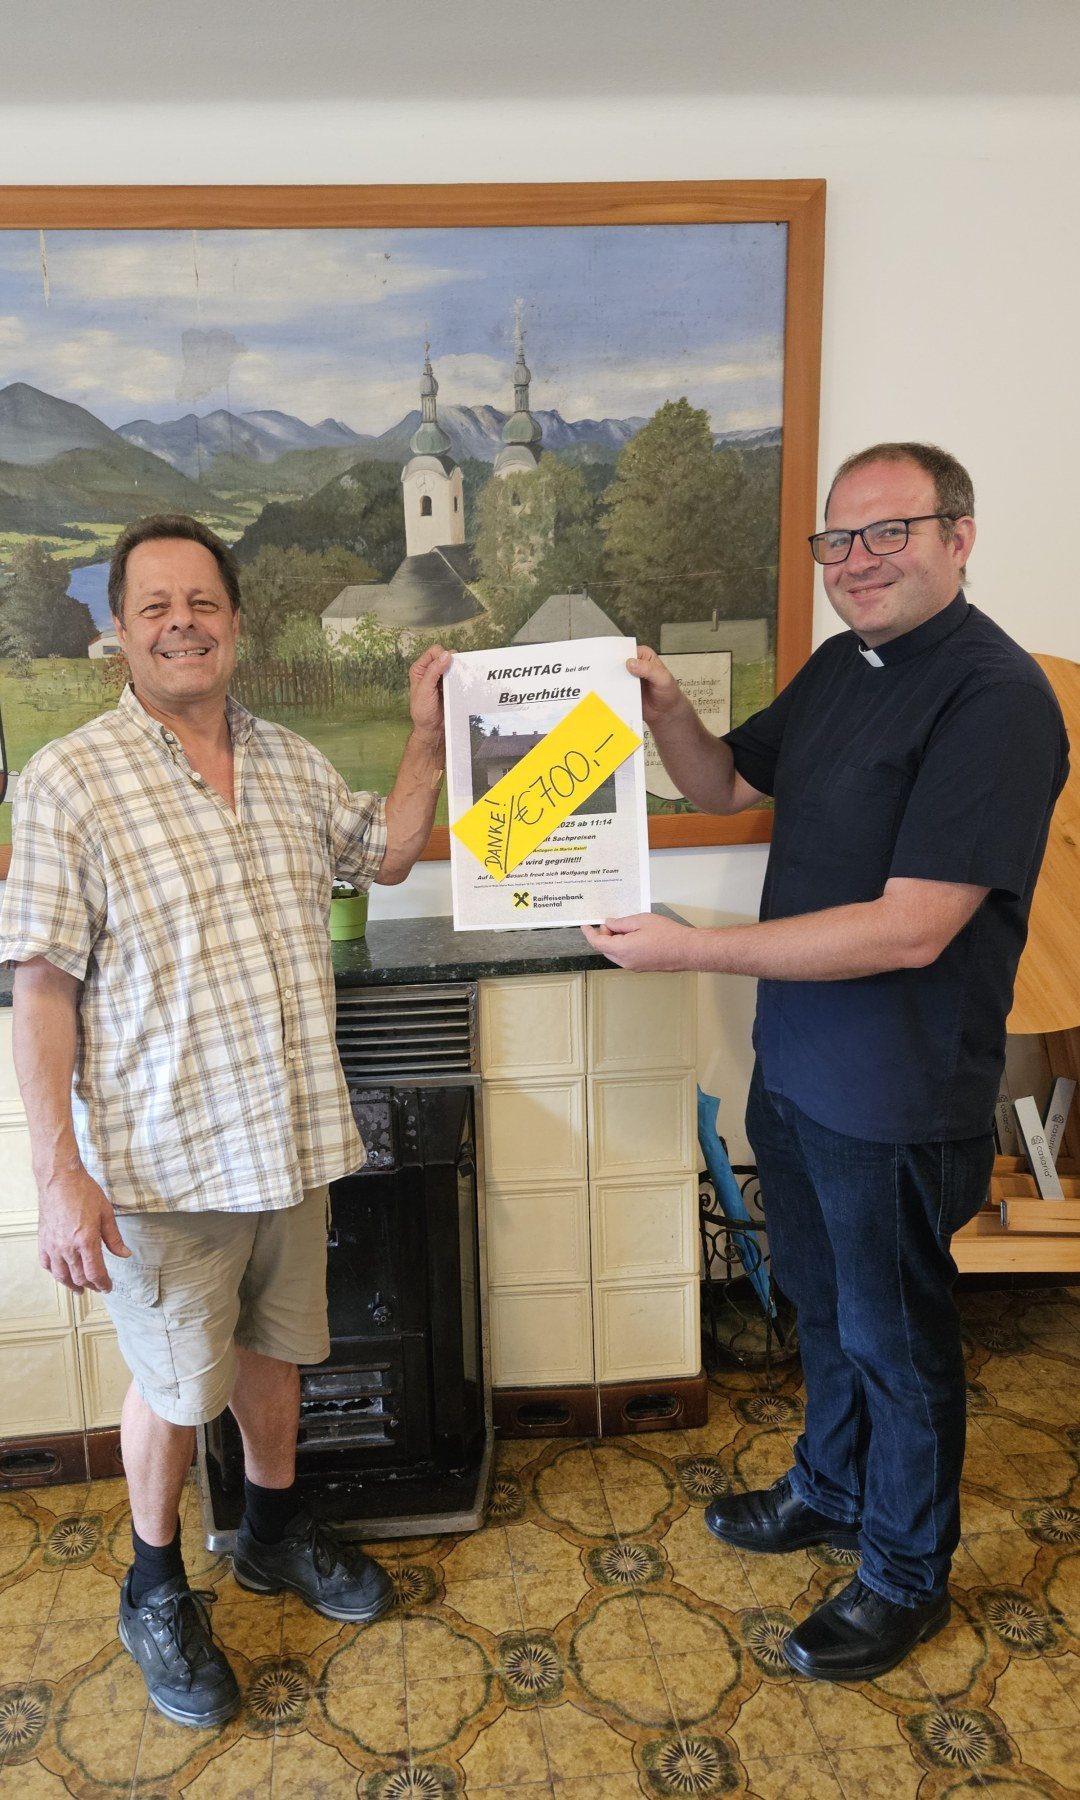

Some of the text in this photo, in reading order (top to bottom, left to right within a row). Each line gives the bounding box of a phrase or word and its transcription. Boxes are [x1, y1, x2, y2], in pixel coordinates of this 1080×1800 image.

[486, 663, 562, 680] KIRCHTAG
[498, 687, 581, 705] Bayerhütte
[557, 821, 576, 829] 025
[484, 798, 507, 870] DANKE!
[552, 834, 597, 843] Sachpreisen
[525, 858, 544, 866] wird
[545, 856, 583, 866] gegrillt!!!
[560, 869, 589, 877] Wolfgang
[533, 893, 584, 902] Raiffeisenbank
[533, 901, 563, 909] Rosental
[1036, 1146, 1050, 1177] casaria
